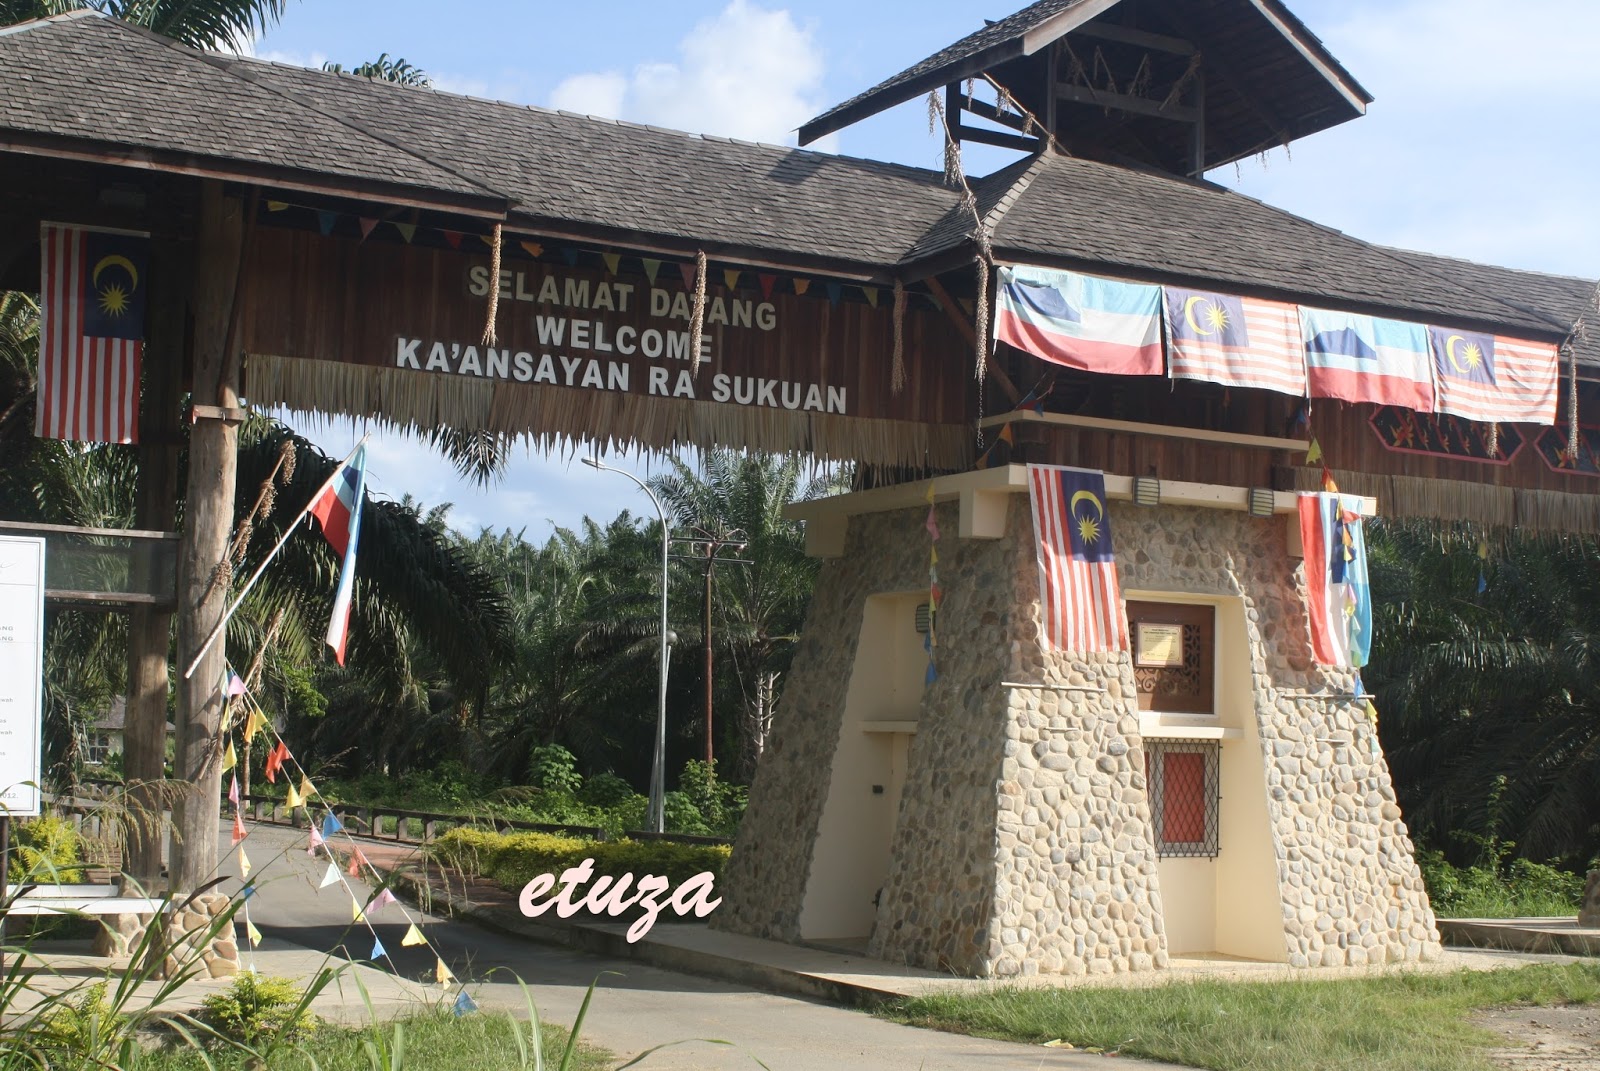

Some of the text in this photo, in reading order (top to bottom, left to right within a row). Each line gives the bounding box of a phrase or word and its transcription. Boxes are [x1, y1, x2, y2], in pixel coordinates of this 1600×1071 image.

[469, 266, 634, 312] SELAMAT
[536, 315, 713, 364] WELCOME
[649, 366, 695, 399] RA
[711, 373, 846, 414] SUKUAN
